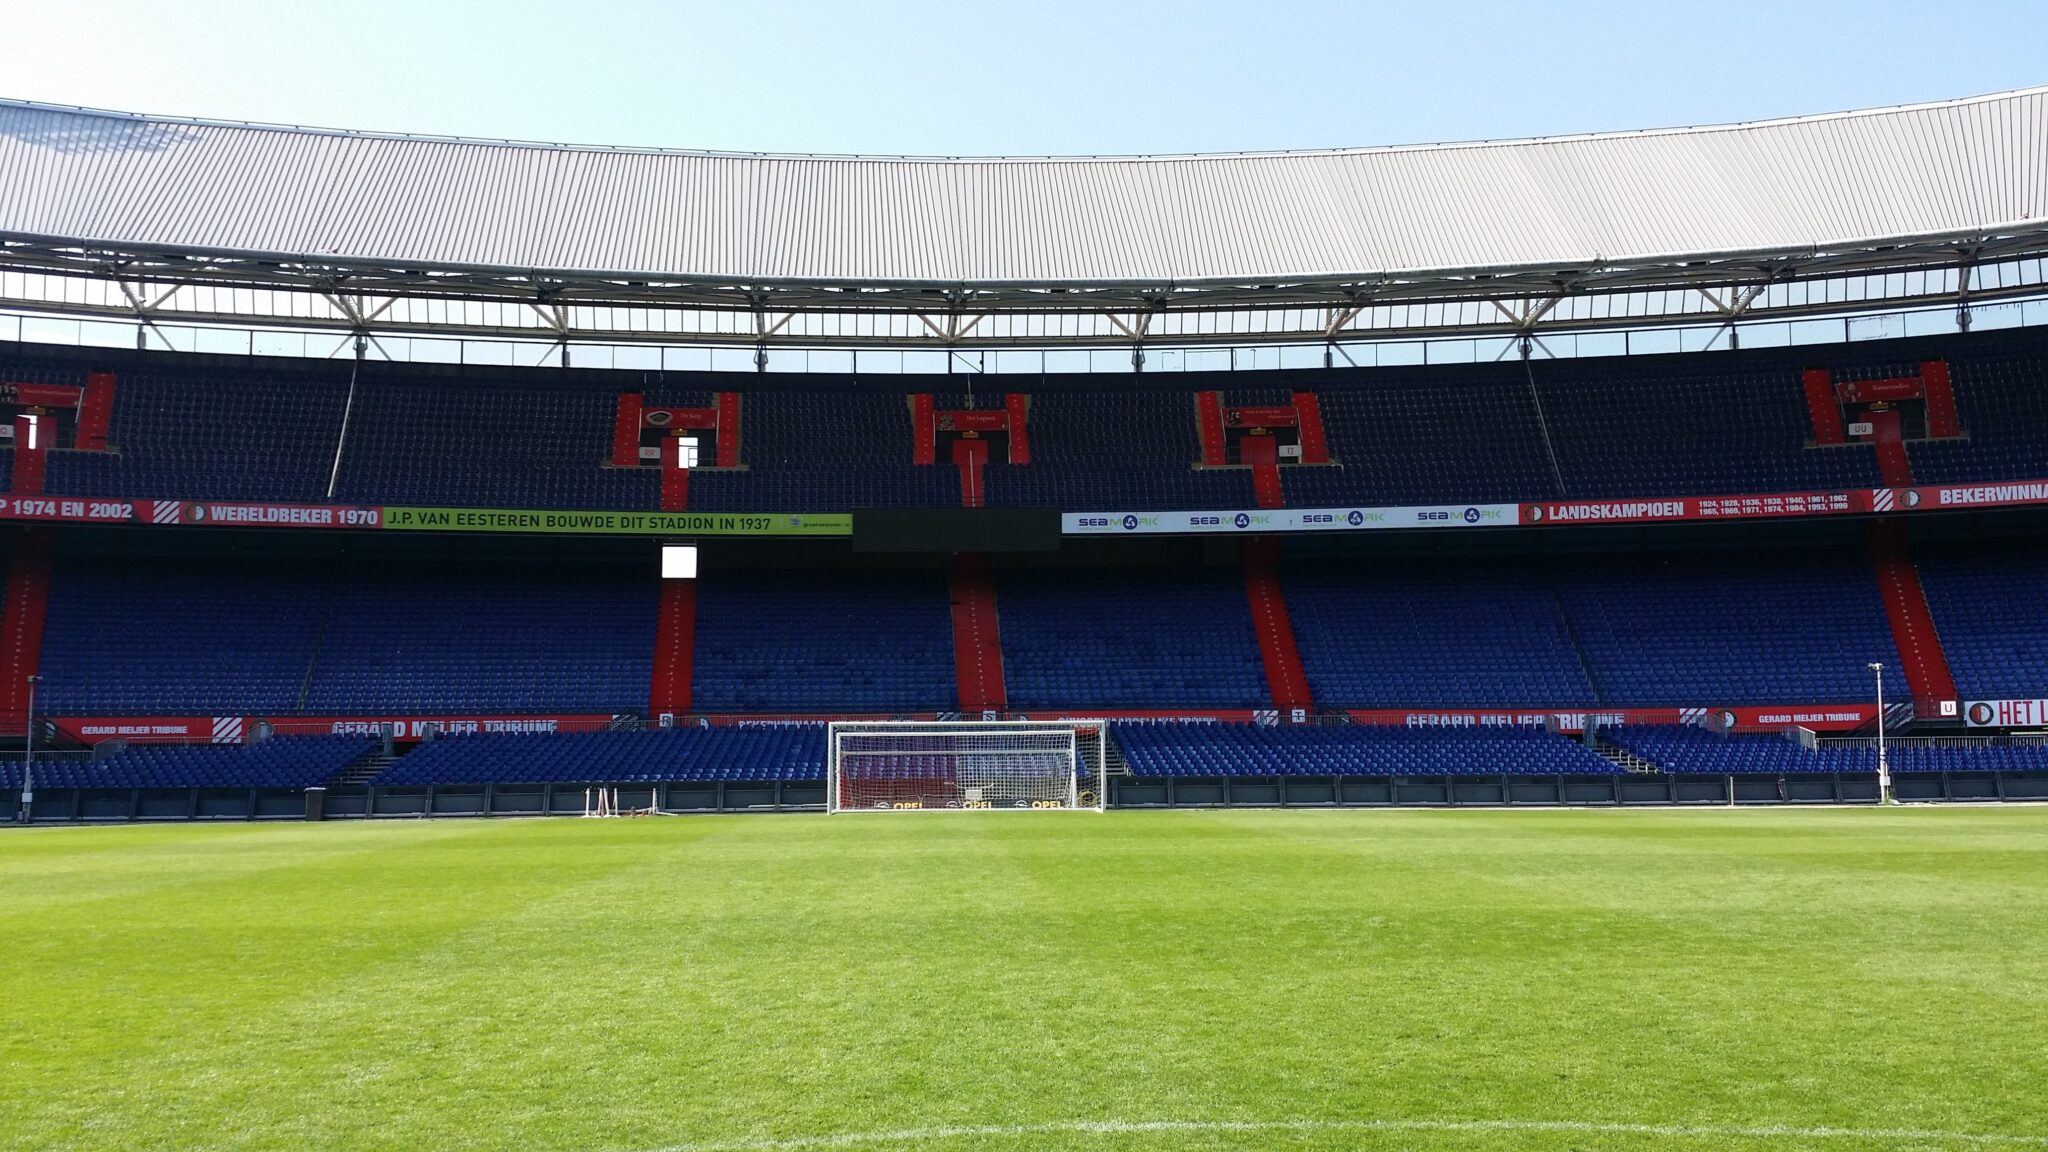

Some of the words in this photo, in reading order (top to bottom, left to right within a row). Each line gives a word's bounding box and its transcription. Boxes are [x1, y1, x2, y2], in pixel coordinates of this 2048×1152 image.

[1940, 484, 2048, 504] BEKERWINNA
[12, 499, 56, 516] 1974
[60, 501, 84, 518] EN
[89, 503, 133, 519] 2002
[211, 506, 332, 524] WERELDBEKER
[337, 509, 378, 525] 1970
[1550, 501, 1684, 520] LANDSKAMPIOEN
[388, 511, 413, 525] J.P.
[418, 512, 450, 526] VAN
[456, 513, 540, 527] EESTEREN
[546, 515, 615, 529] BOUWDE
[620, 516, 645, 529] DIT
[649, 517, 714, 530] STADION
[719, 518, 735, 530] IN
[739, 518, 771, 530] 1937
[986, 712, 993, 722] S
[1945, 703, 1953, 712] U
[1998, 701, 2033, 724] HET
[1758, 715, 1792, 723] GERARD
[1793, 714, 1824, 722] MEIJER
[1825, 713, 1861, 721] TRIBUNE
[81, 726, 116, 735] GERARD
[118, 726, 150, 735] MEIJER
[152, 726, 188, 734] TRIBUNE
